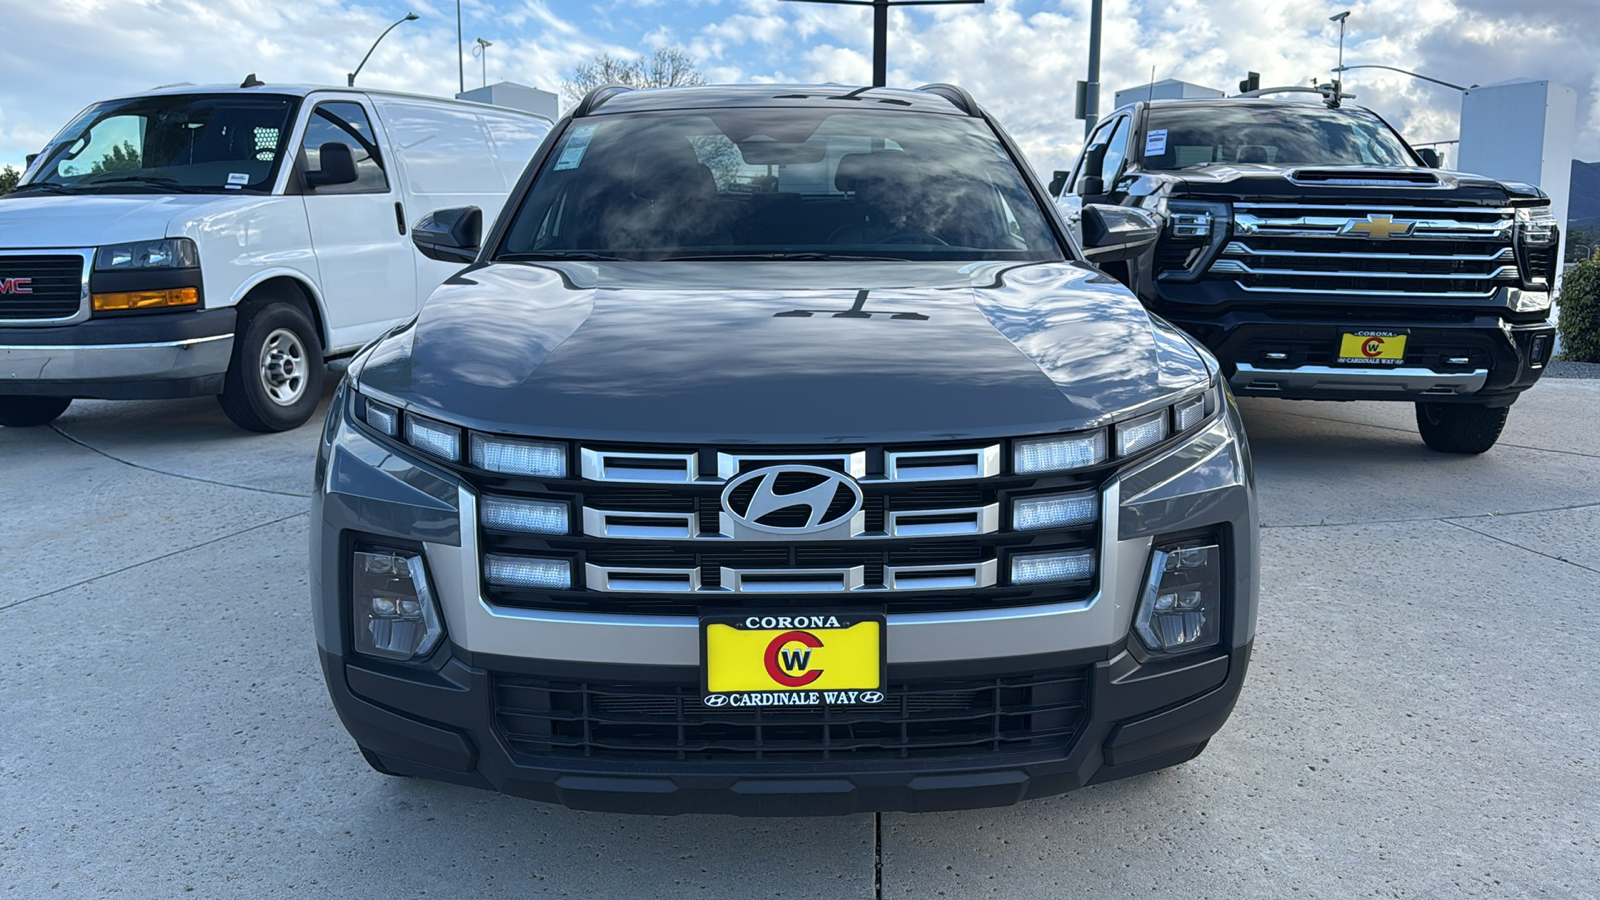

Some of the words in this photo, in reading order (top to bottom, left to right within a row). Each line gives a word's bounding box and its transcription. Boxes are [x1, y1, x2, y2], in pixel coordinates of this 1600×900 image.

[745, 615, 841, 629] CORONA
[729, 691, 820, 707] CARDINALE
[823, 691, 859, 705] WAY
